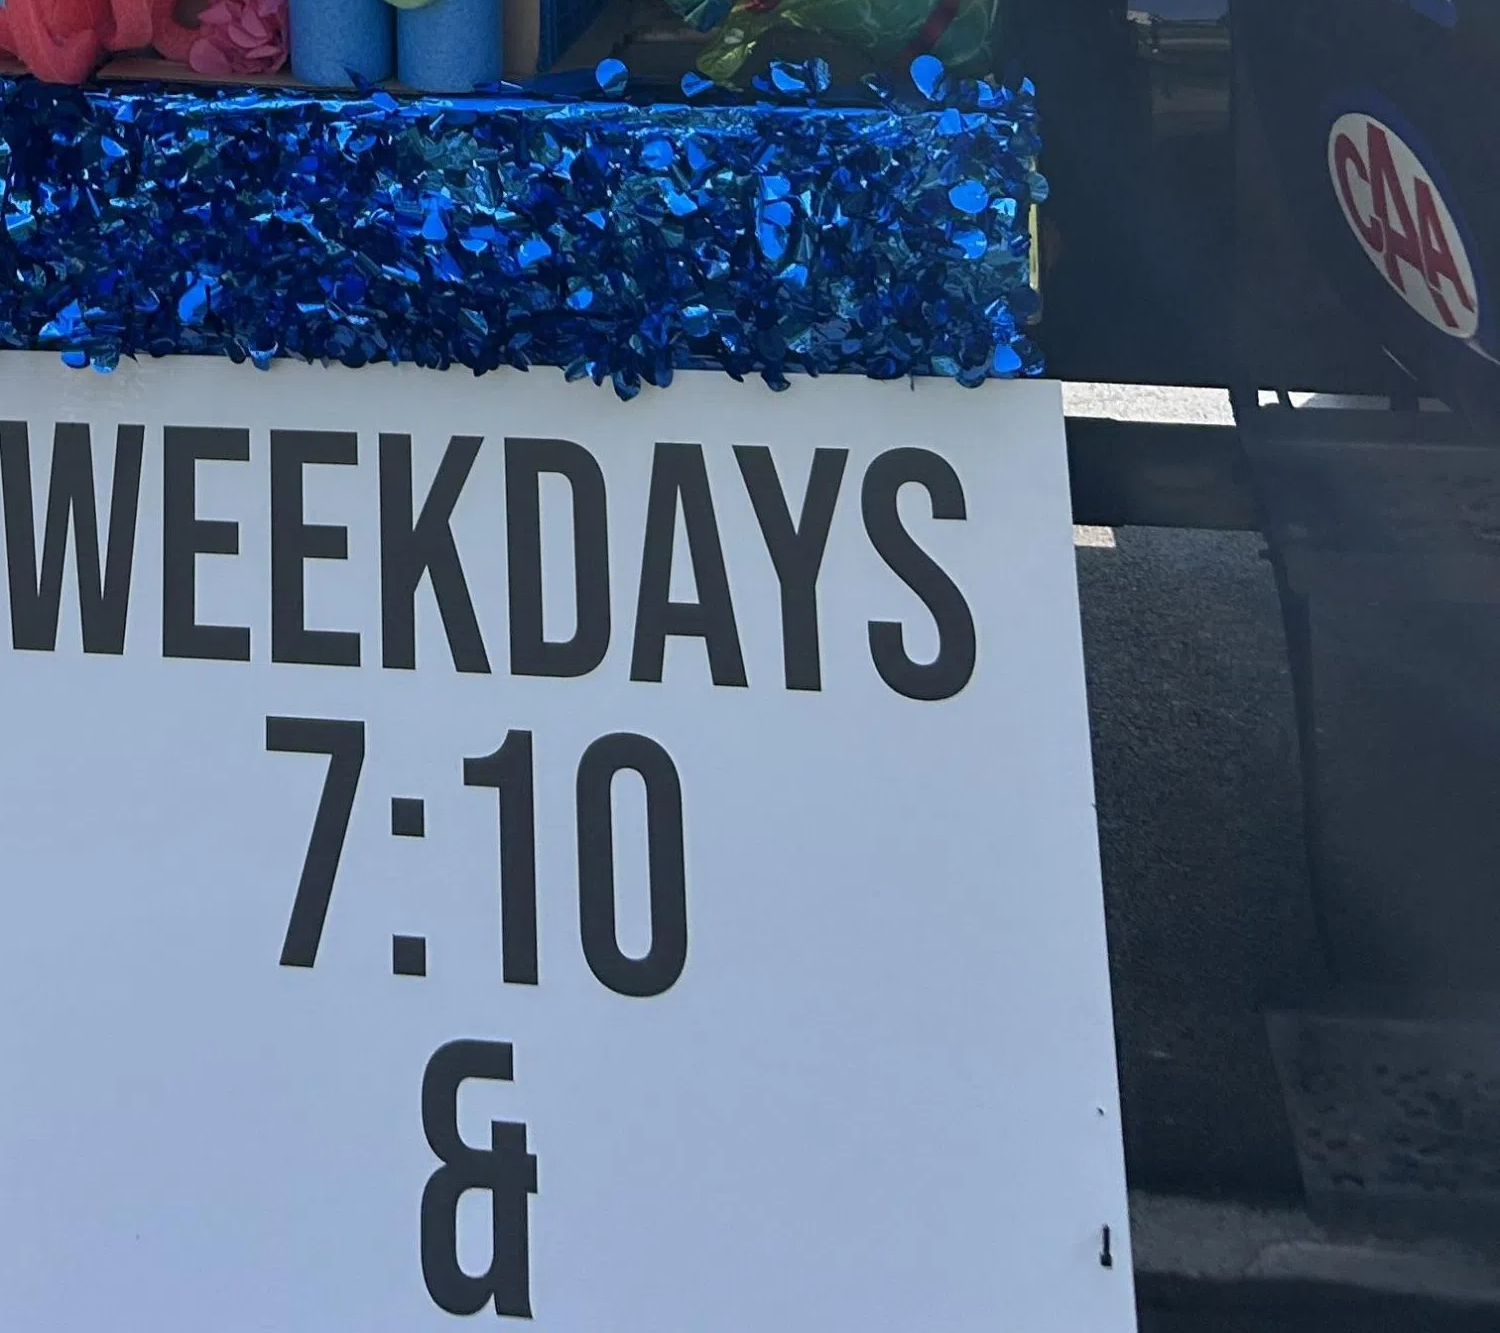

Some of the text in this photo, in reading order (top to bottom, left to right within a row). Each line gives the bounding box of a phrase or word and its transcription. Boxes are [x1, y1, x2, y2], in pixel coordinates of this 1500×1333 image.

[1333, 121, 1475, 328] CAA
[264, 715, 689, 999] 7:10
[420, 1038, 538, 1320] &
